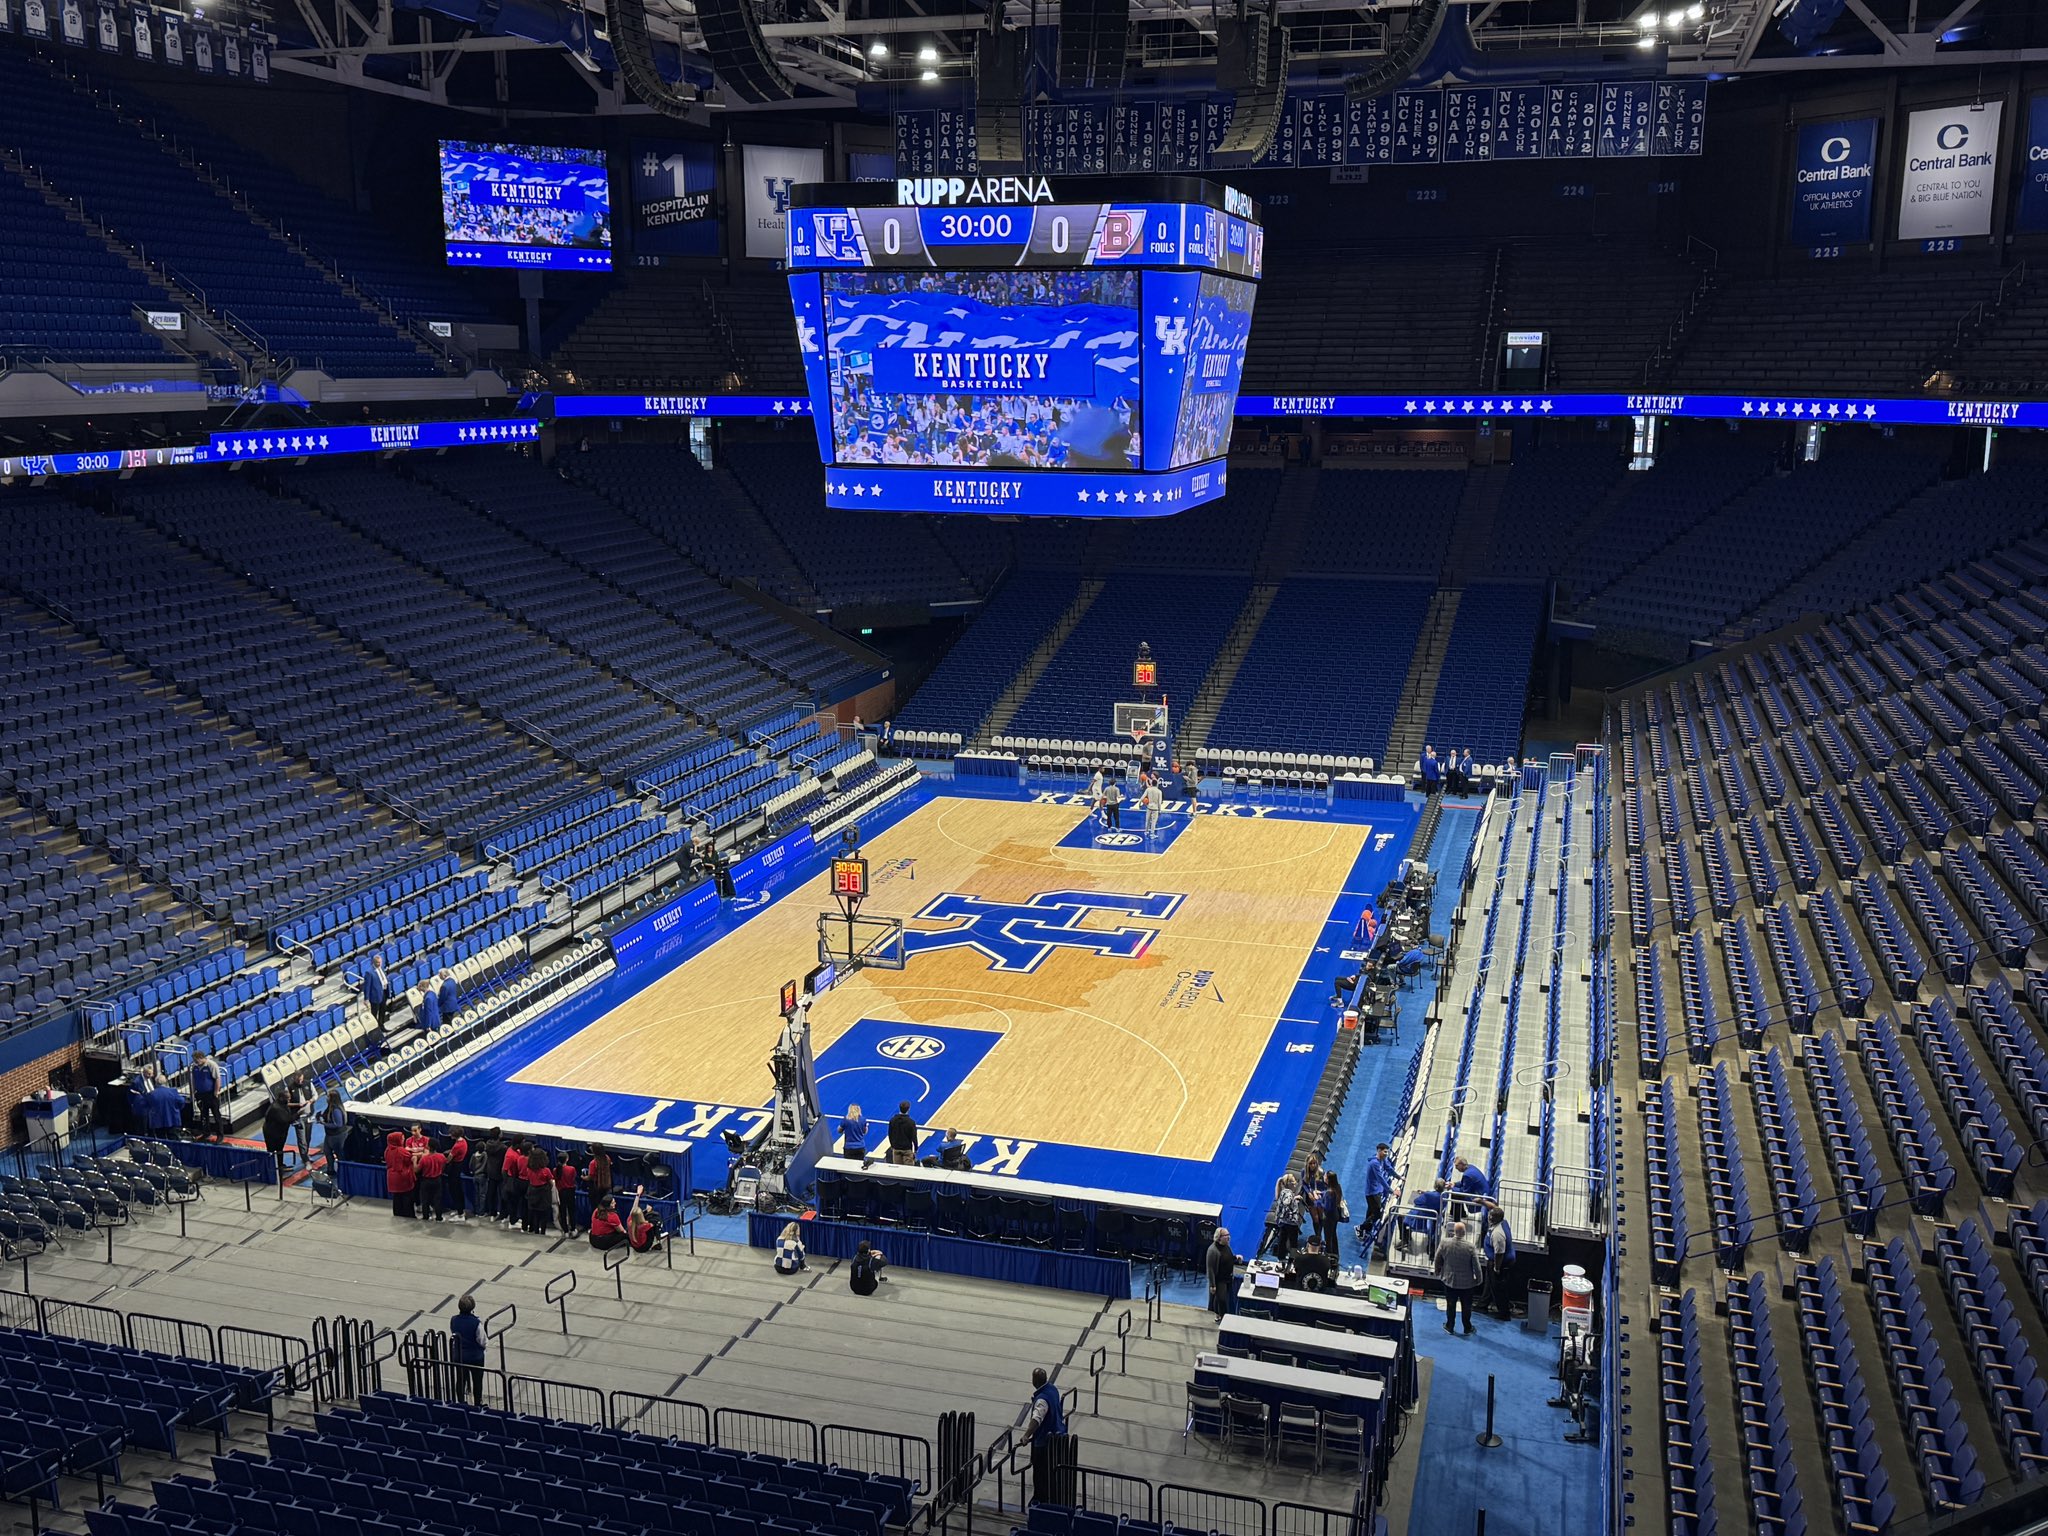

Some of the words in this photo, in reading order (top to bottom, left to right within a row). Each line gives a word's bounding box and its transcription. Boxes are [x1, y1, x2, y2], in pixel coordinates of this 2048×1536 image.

[1516, 94, 1526, 124] FINAL
[1549, 89, 1564, 140] NCAA
[1603, 87, 1619, 138] NCAA
[1622, 90, 1633, 130] RUNNER
[1655, 86, 1673, 137] NCAA
[1676, 89, 1686, 120] FINAL
[1302, 100, 1314, 150] NCAA
[1396, 96, 1410, 146] NCAA
[1448, 93, 1462, 144] NCAA
[1465, 94, 1477, 155] CHAMPION
[1497, 91, 1512, 141] NCAA
[1565, 92, 1578, 151] CHAMPION
[1689, 100, 1703, 150] 2015
[940, 112, 950, 159] NCAA
[1068, 109, 1078, 157] NCAA
[1114, 107, 1126, 156] NCAA
[1160, 107, 1172, 155] NCAA
[1331, 113, 1342, 162] 1993
[1379, 110, 1390, 158] 1996
[1426, 108, 1438, 157] 1997
[1478, 106, 1491, 156] 1998
[1529, 104, 1542, 154] 2011
[1581, 103, 1594, 153] 2012
[1635, 102, 1648, 152] 2014
[1674, 123, 1684, 148] FOUR
[898, 115, 907, 162] NCAA
[955, 114, 964, 171] CHAMPION
[1056, 124, 1065, 170] 1951
[1083, 111, 1092, 168] CHAMPION
[1095, 122, 1105, 169] 1958
[1143, 121, 1153, 168] 1966
[1189, 119, 1198, 166] 1975
[1282, 115, 1293, 163] 1984
[1515, 128, 1525, 152] FOUR
[1621, 136, 1629, 149] UP
[924, 127, 933, 173] 1942
[1412, 144, 1421, 156] UP
[1909, 155, 1955, 172] Central
[1959, 152, 1992, 168] Bank
[642, 151, 685, 198] #1
[1797, 167, 1838, 183] Central
[1840, 163, 1872, 179] Bank
[491, 183, 562, 200] KENTUCKY
[898, 178, 964, 206] RUPP
[966, 176, 1054, 203] ARENA
[1416, 190, 1437, 200] 223
[1563, 186, 1584, 196] 224
[1658, 182, 1674, 192] 224
[1802, 191, 1830, 202] OFFICIAL
[1831, 190, 1851, 200] BANK
[1852, 189, 1863, 198] OF
[1910, 194, 1916, 203] &
[1918, 193, 1931, 202] BIG
[1932, 192, 1949, 202] BLUE
[1951, 190, 1982, 200] NATION
[1917, 182, 1948, 192] CENTRAL
[1951, 181, 1961, 190] TO
[1963, 180, 1980, 189] YOU
[506, 197, 549, 205] BASKETBALL
[642, 198, 695, 215] HOSPITAL
[697, 194, 709, 206] IN
[1269, 195, 1289, 205] 223
[1809, 202, 1819, 211] UK
[1820, 200, 1853, 210] ATHLETICS
[646, 207, 706, 227] KENTUCKY
[758, 219, 785, 230] Healt
[941, 215, 1012, 238] 30:00
[797, 227, 804, 243] 0
[884, 218, 900, 256] 0
[1052, 216, 1068, 254] 0
[1158, 222, 1166, 240] 0
[1194, 224, 1200, 241] 0
[1230, 224, 1244, 248] 30:00
[507, 251, 552, 261] KENTUCKY
[793, 244, 810, 256] FOULS
[1150, 242, 1175, 253] FOULS
[1189, 243, 1204, 254] FOULS
[1814, 247, 1839, 258] 225
[1927, 240, 1954, 252] 225
[638, 256, 660, 266] 218
[1155, 315, 1188, 355] UK
[914, 353, 1049, 379] KENTUCKY
[942, 379, 1023, 389] BASKETBALL
[644, 397, 707, 410] KENTUCKY
[1273, 397, 1335, 410] KENTUCKY
[1627, 396, 1683, 410] KENTUCKY
[1948, 402, 2020, 419] KENTUCKY
[370, 425, 419, 443] KENTUCKY
[1480, 428, 1490, 436] 23
[4, 460, 11, 474] 0
[20, 455, 49, 476] UK
[77, 455, 109, 469] 30:00
[157, 450, 163, 463] 0
[934, 480, 1022, 499] KENTUCKY
[1191, 472, 1210, 492] KENTUCKY
[1136, 671, 1152, 683] 30
[1097, 834, 1141, 845] SEC
[762, 845, 785, 866] KENTUCKY
[836, 862, 862, 873] 30:00
[839, 873, 859, 891] 30
[653, 906, 682, 932] KENTUCKY
[880, 1036, 942, 1058] SEC
